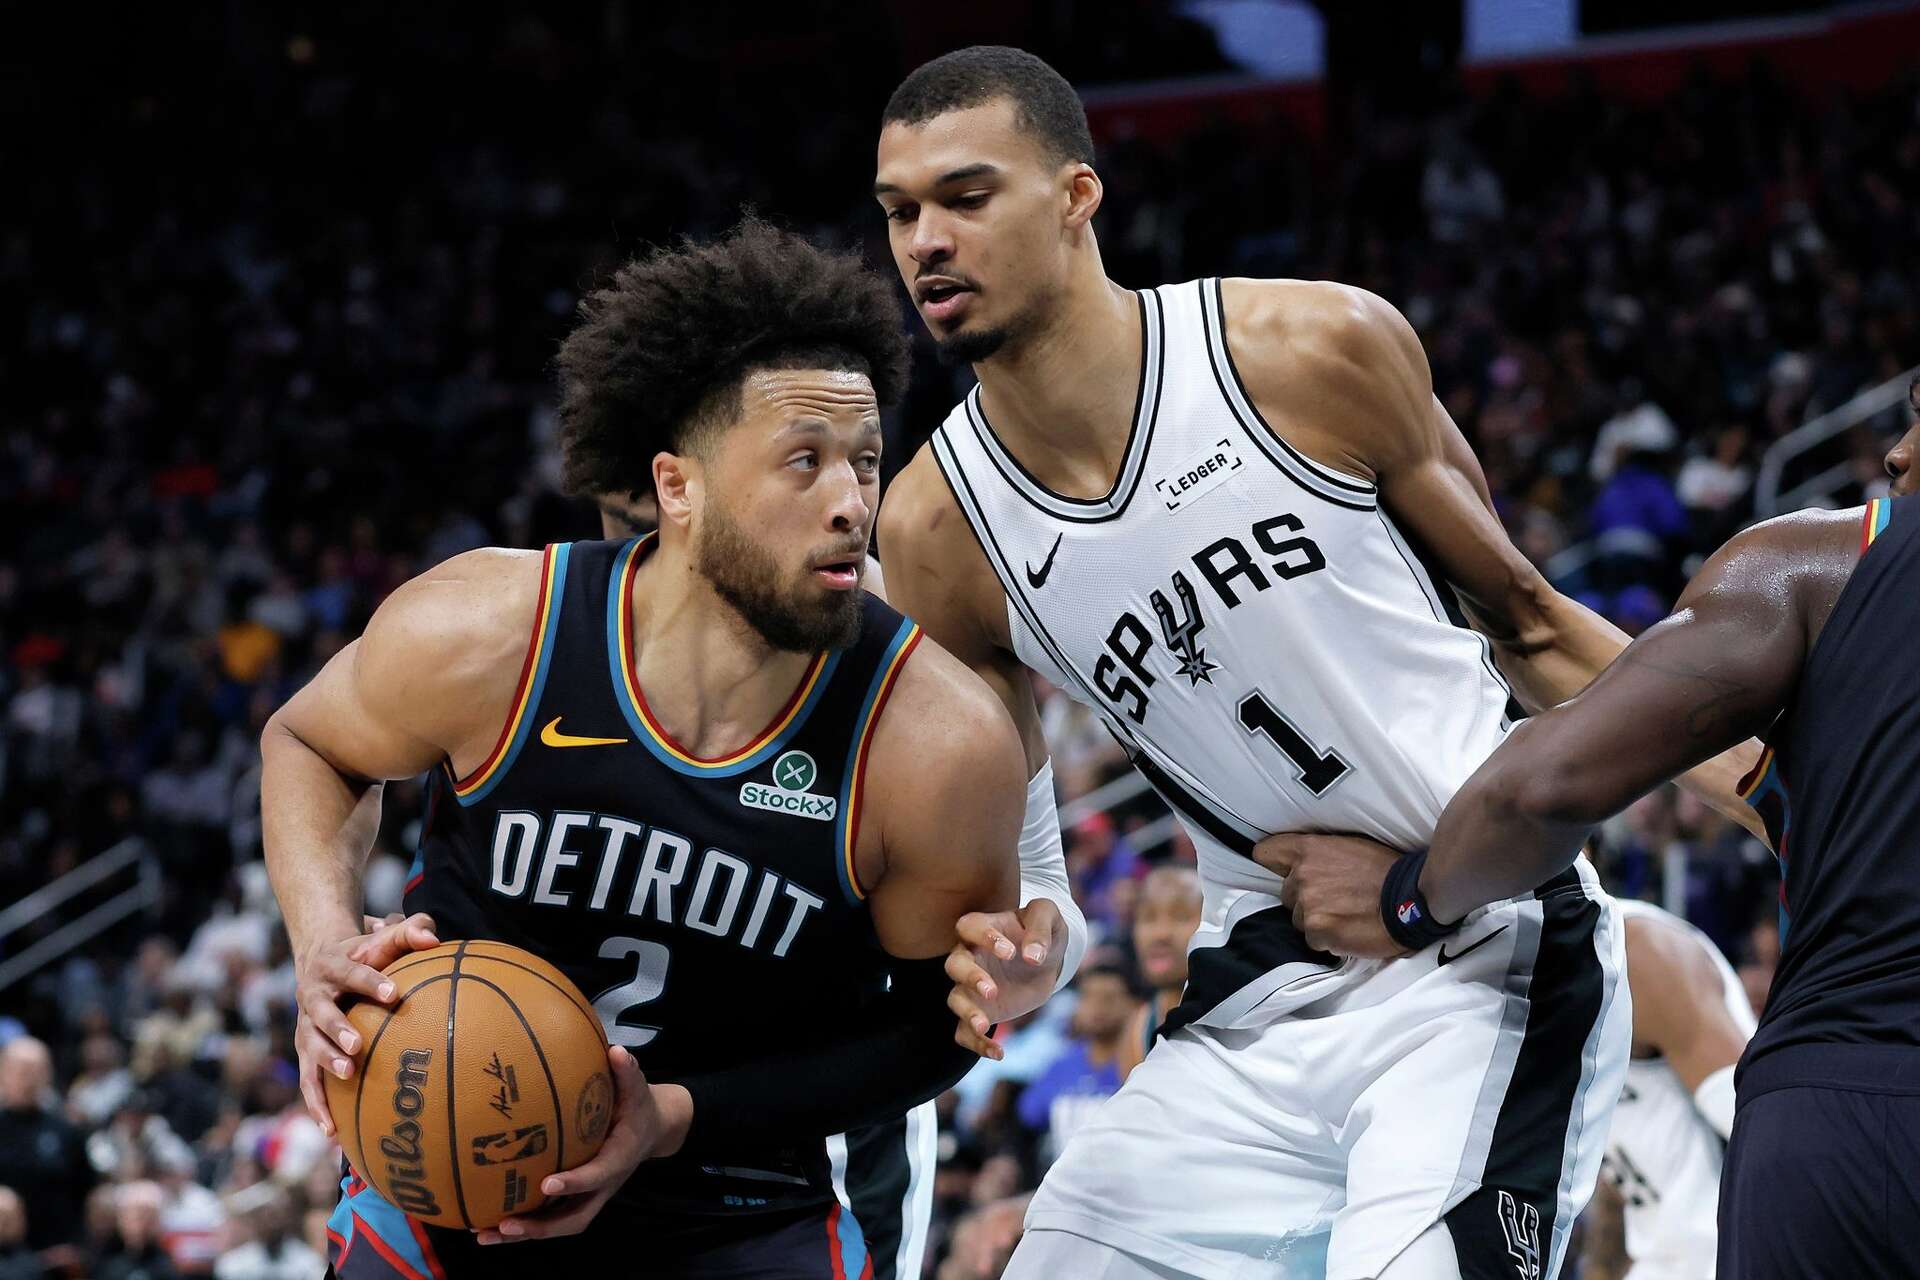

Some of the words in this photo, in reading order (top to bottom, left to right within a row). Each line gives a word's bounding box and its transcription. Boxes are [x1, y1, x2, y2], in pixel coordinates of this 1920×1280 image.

[1168, 453, 1228, 497] LEDGER
[1093, 512, 1327, 725] SPURS
[1235, 687, 1356, 799] 1
[742, 786, 834, 817] StockX
[490, 810, 825, 958] DETROIT
[592, 935, 670, 1048] 2
[379, 1047, 442, 1217] Wilson
